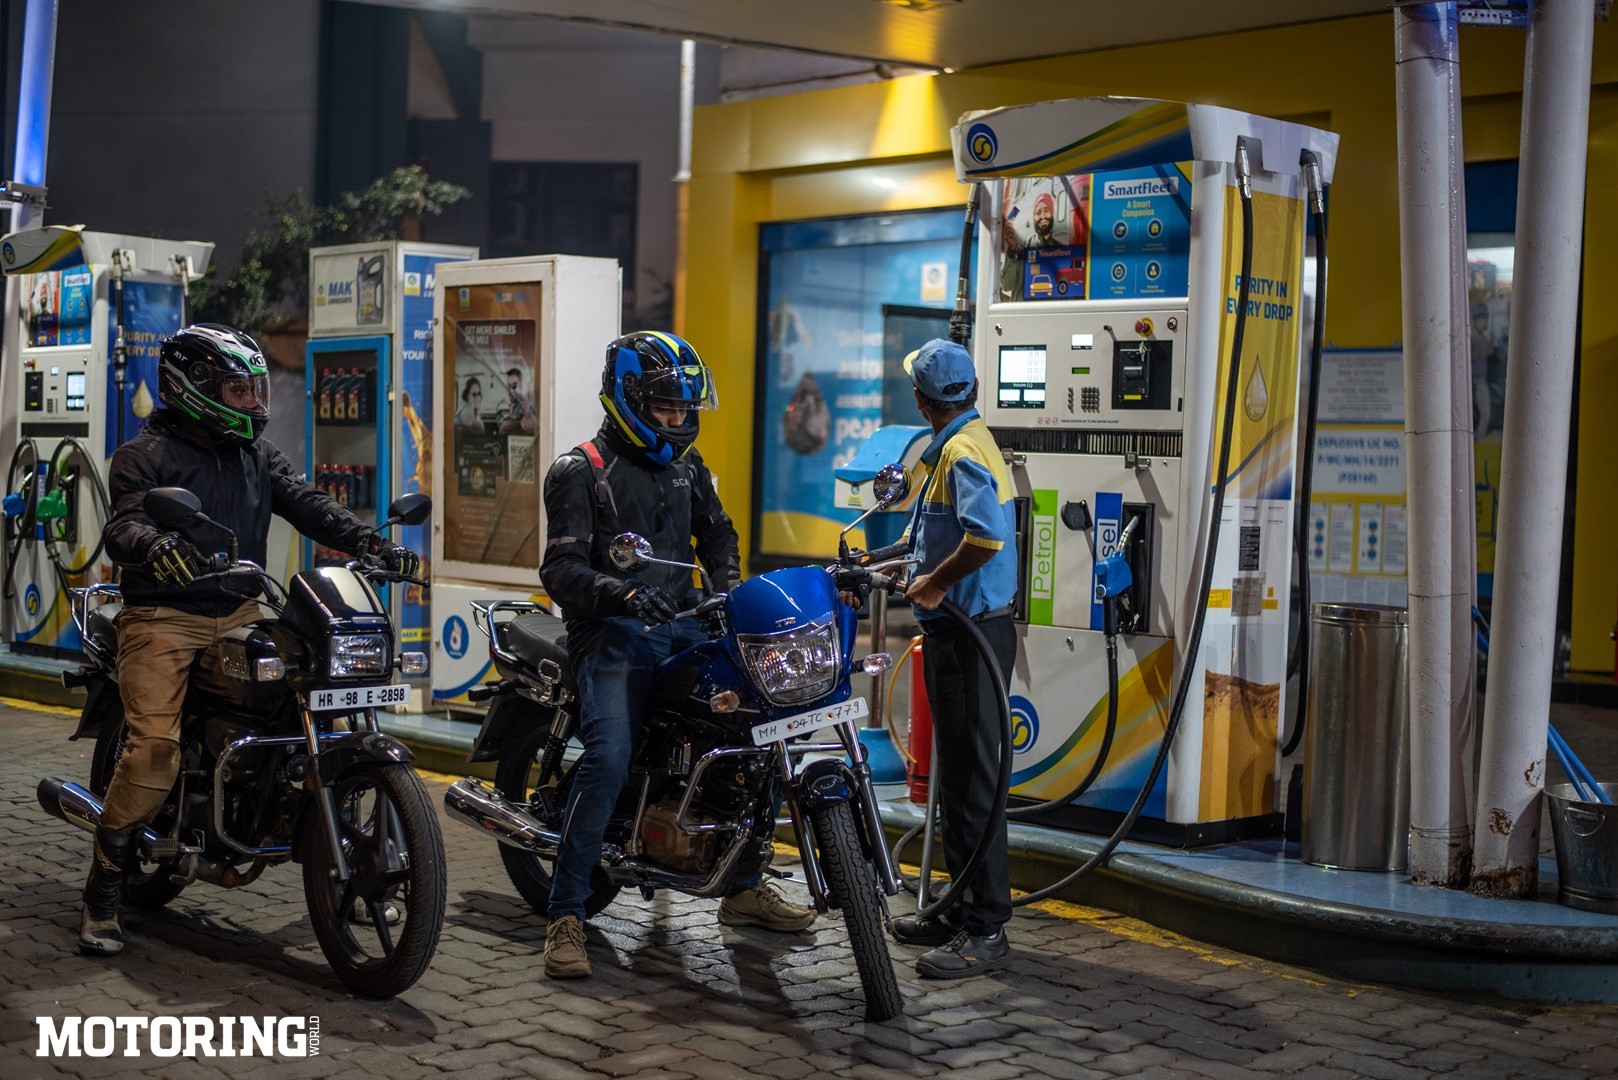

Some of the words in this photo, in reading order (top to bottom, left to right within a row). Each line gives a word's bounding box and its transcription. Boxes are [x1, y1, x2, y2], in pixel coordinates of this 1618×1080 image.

[1108, 182, 1172, 196] SmartFleet
[1133, 200, 1150, 208] Smart
[1122, 209, 1154, 217] Companion
[329, 281, 352, 296] MAK
[1234, 275, 1273, 296] PRITY
[1276, 281, 1287, 298] IN
[1227, 297, 1262, 317] EVRY
[1264, 302, 1293, 321] DROP
[494, 325, 516, 335] SMILES
[1032, 521, 1052, 593] Petrol
[319, 694, 333, 707] HR
[346, 692, 358, 705] 98
[367, 691, 373, 703] E
[381, 688, 405, 702] 2898
[758, 726, 777, 739] MH
